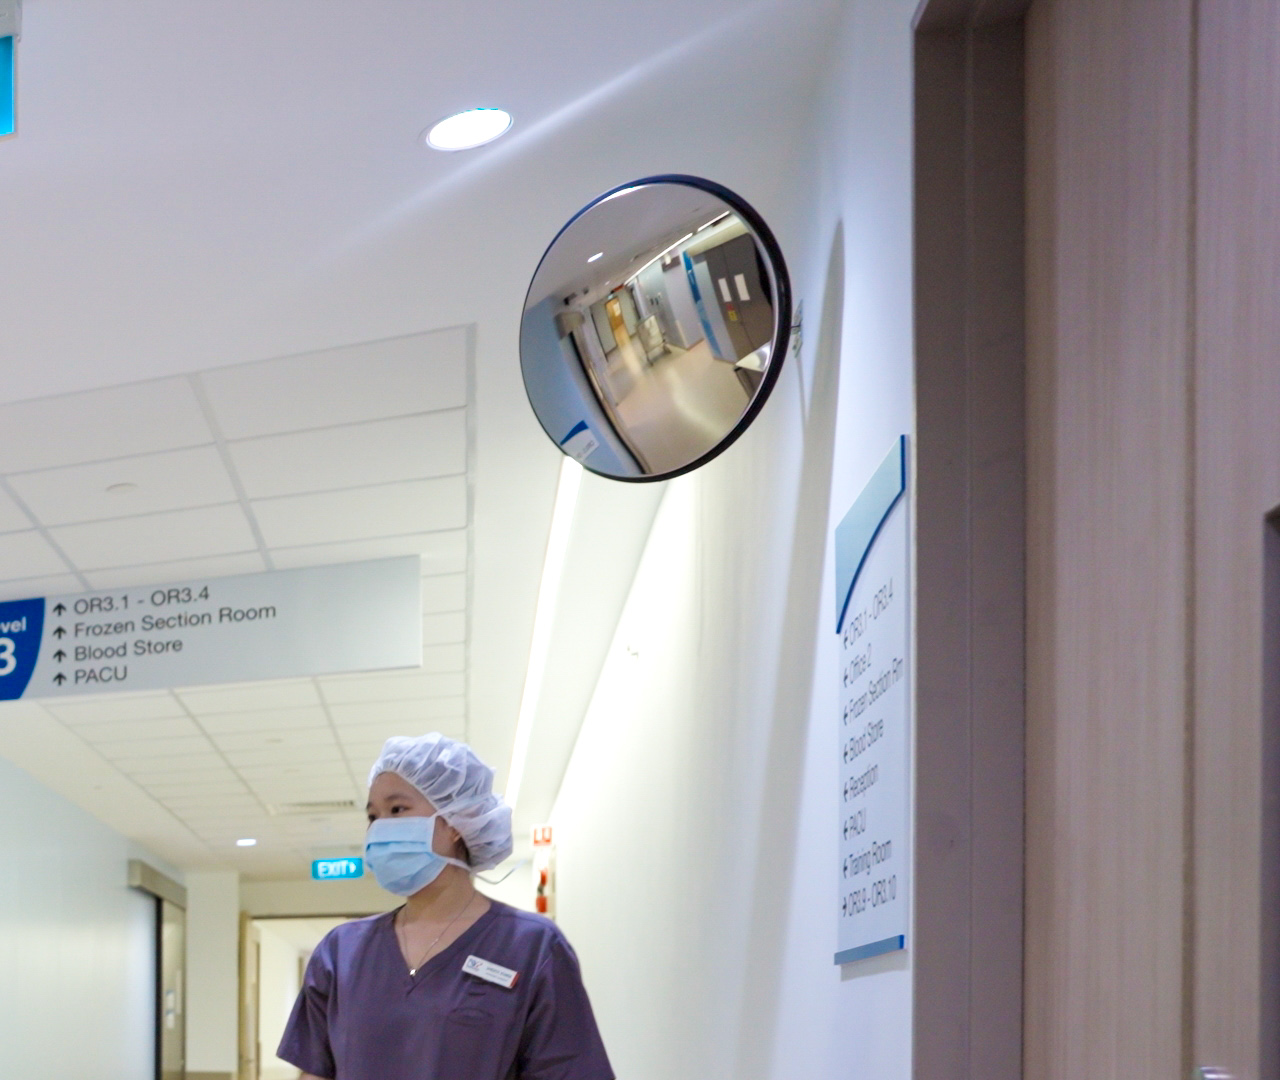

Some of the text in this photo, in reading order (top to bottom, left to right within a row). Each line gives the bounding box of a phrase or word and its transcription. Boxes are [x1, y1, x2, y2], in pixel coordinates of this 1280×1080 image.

[73, 595, 129, 615] OR3.1
[150, 585, 209, 607] OR3.4
[849, 609, 867, 646] OR3.1
[872, 577, 893, 621] OR3.4
[74, 605, 276, 638] Frozen Section Room
[74, 639, 183, 662] Blood Store
[74, 666, 128, 685] PACU
[869, 670, 891, 706] Section
[849, 719, 884, 761] Blood Store
[849, 764, 879, 800] Reception
[849, 808, 866, 839] PACU
[317, 860, 348, 877] EXIT
[849, 840, 892, 878] Training Room
